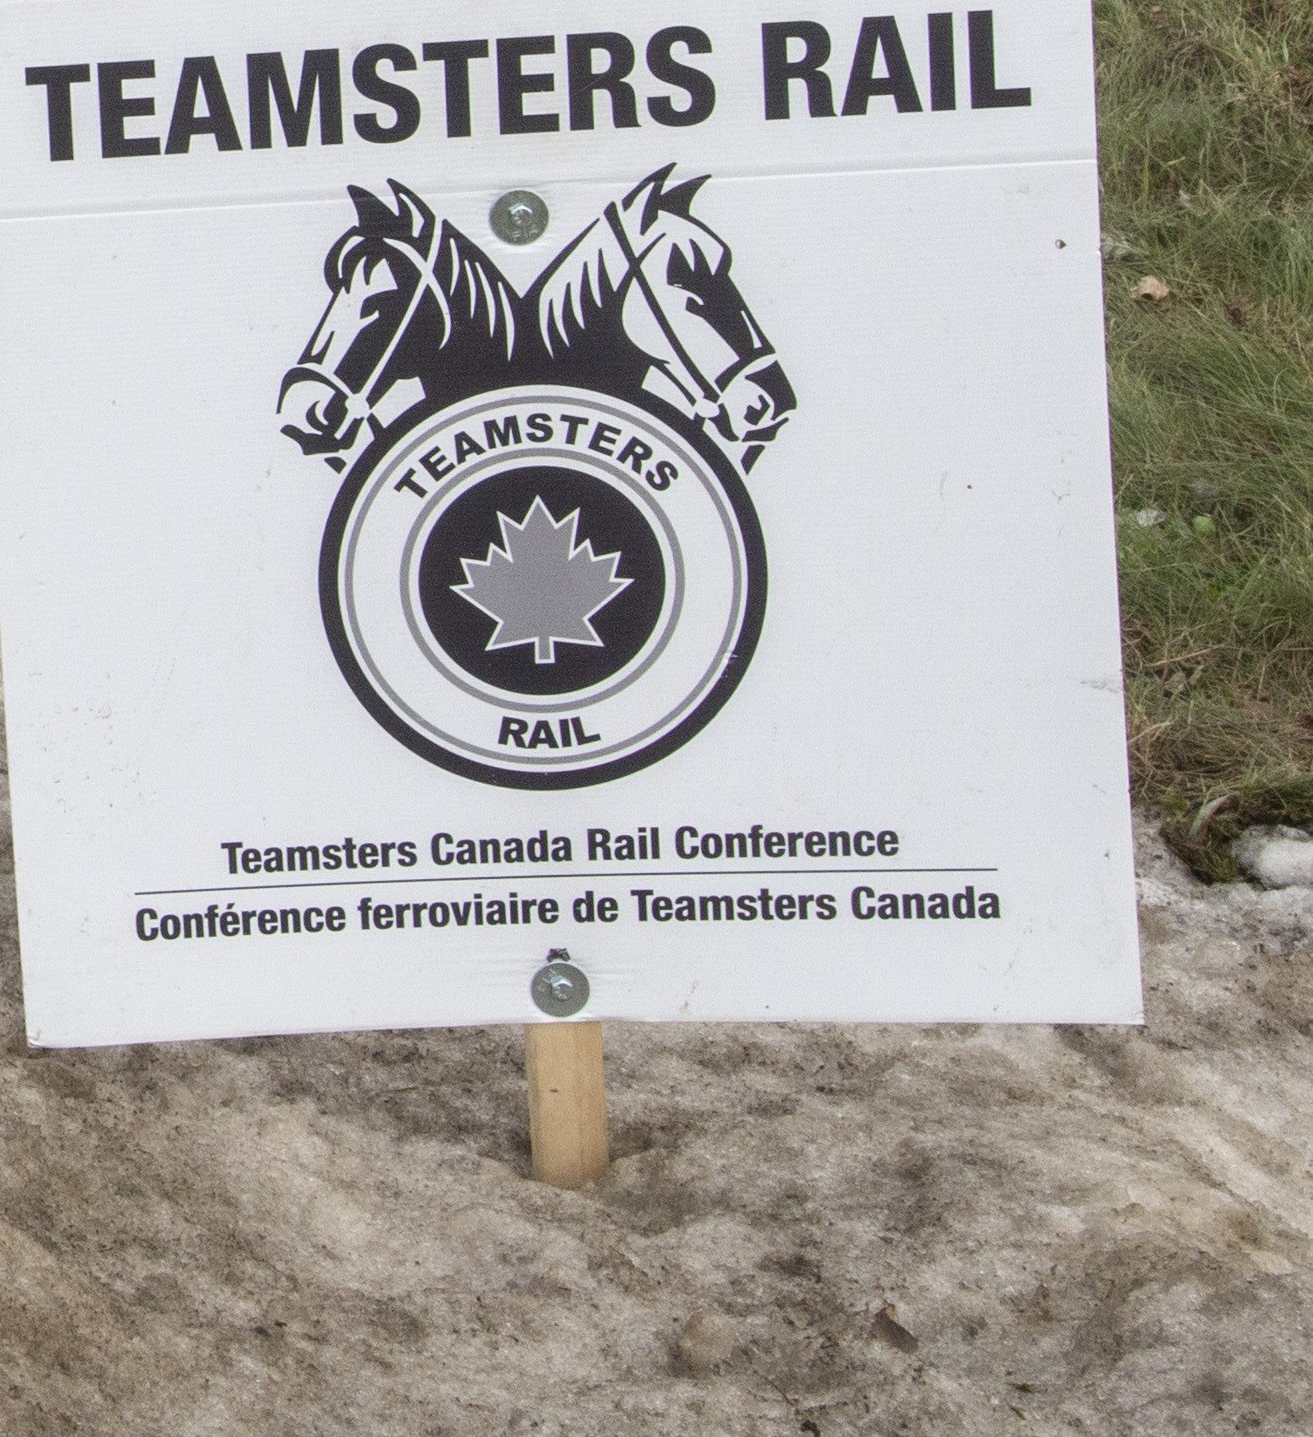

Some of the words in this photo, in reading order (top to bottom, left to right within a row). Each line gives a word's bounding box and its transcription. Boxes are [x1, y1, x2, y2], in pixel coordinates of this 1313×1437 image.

[25, 26, 715, 161] TEAMSTERS
[762, 10, 1031, 120] RAIL
[394, 413, 678, 498] TEAMSTERS
[498, 717, 600, 748] RAIL
[221, 838, 417, 874] Teamsters
[432, 830, 572, 865] Canada
[588, 828, 660, 860] Rail
[676, 825, 898, 859] Conference
[136, 903, 345, 941] Conférence
[358, 893, 558, 929] ferroviaire
[573, 891, 618, 923] de
[631, 889, 836, 921] Teamsters
[852, 886, 1000, 919] Canada
